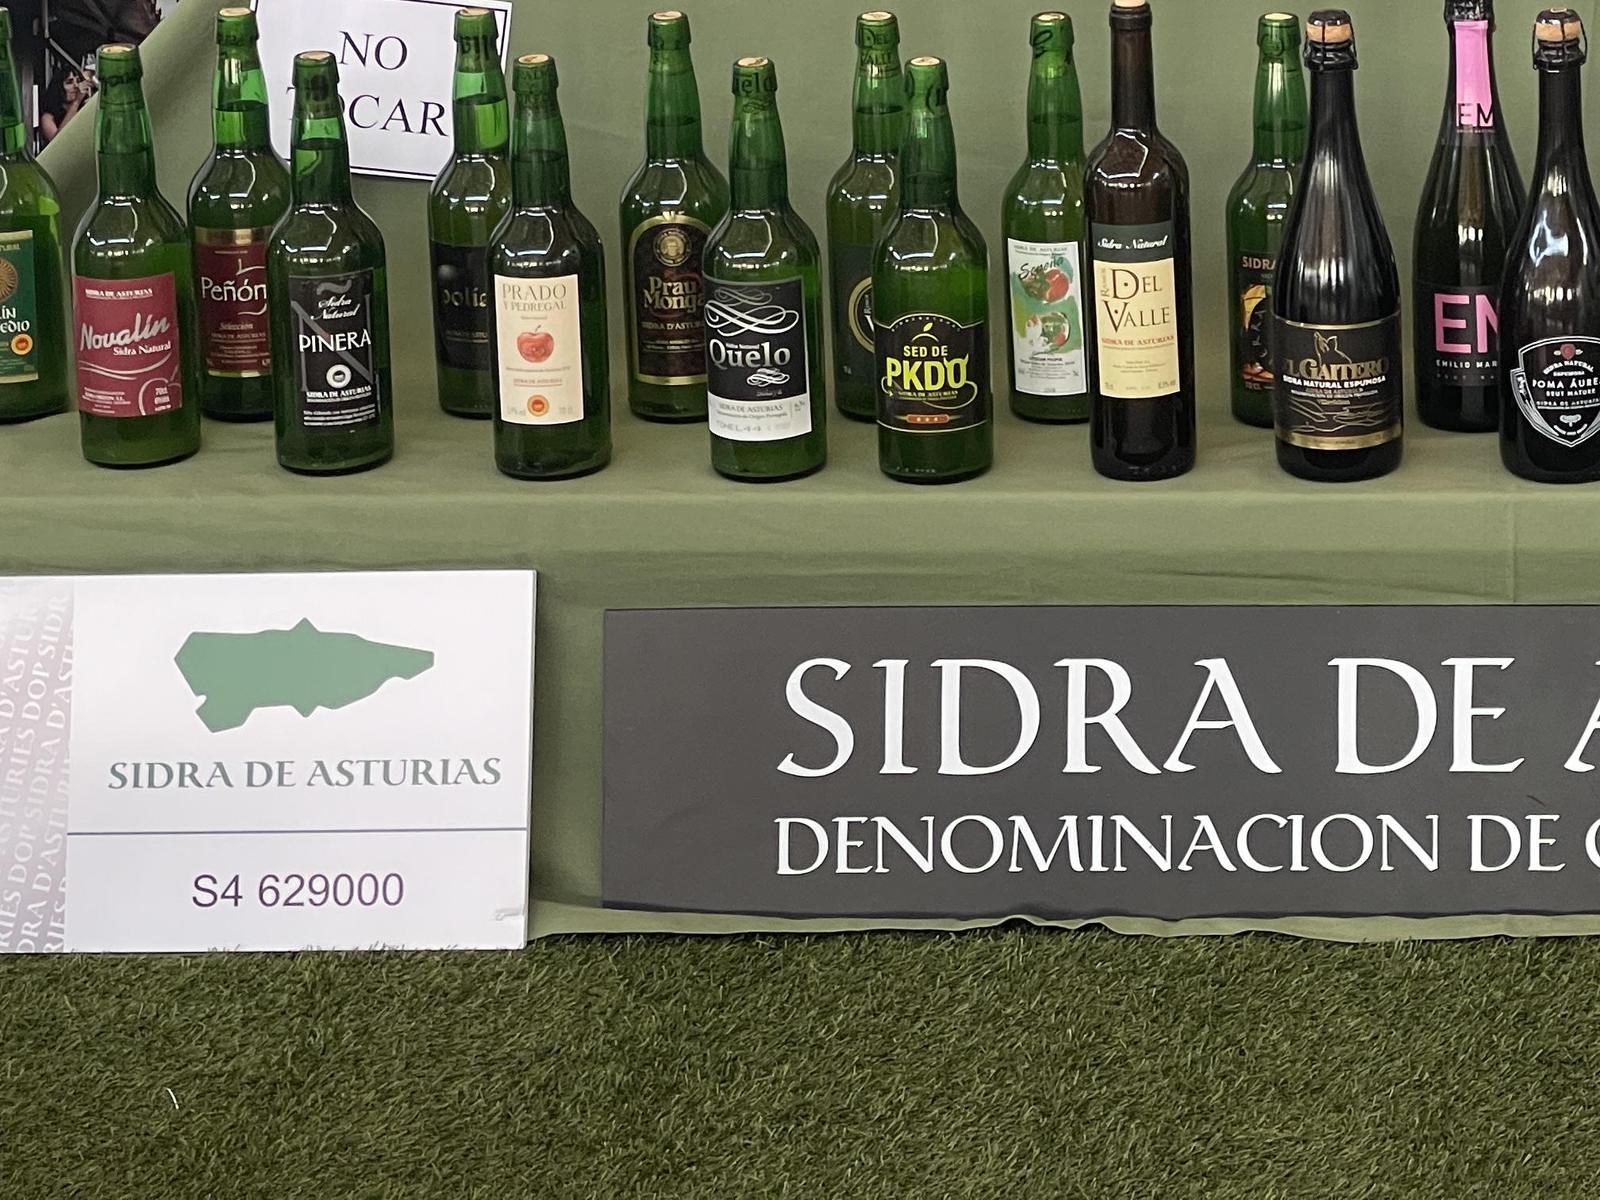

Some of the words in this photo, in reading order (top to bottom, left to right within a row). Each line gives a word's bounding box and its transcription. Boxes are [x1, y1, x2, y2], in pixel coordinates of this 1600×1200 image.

[338, 30, 408, 72] NO
[287, 92, 449, 138] CAR
[1098, 237, 1123, 250] Sidra
[1126, 235, 1169, 250] Natural
[201, 275, 268, 303] Peñón
[502, 282, 567, 300] PRADO
[1111, 268, 1163, 300] DEL
[513, 301, 567, 312] PEDREGAL
[1103, 299, 1171, 333] VALLE
[113, 345, 136, 357] Sidra
[138, 341, 172, 355] Natural
[903, 346, 927, 356] SED
[931, 346, 948, 356] DE
[1303, 378, 1342, 389] NATURAL
[1532, 379, 1566, 390] POMA
[776, 656, 1283, 776] SIDRA
[1326, 656, 1526, 775] DE
[108, 761, 235, 790] SIDRA
[245, 760, 296, 788] DE
[306, 756, 502, 788] ASTURIAS
[773, 811, 1441, 876] DENOMINACION
[1468, 812, 1566, 874] DE
[192, 873, 244, 909] S4
[257, 872, 405, 908] 629000
